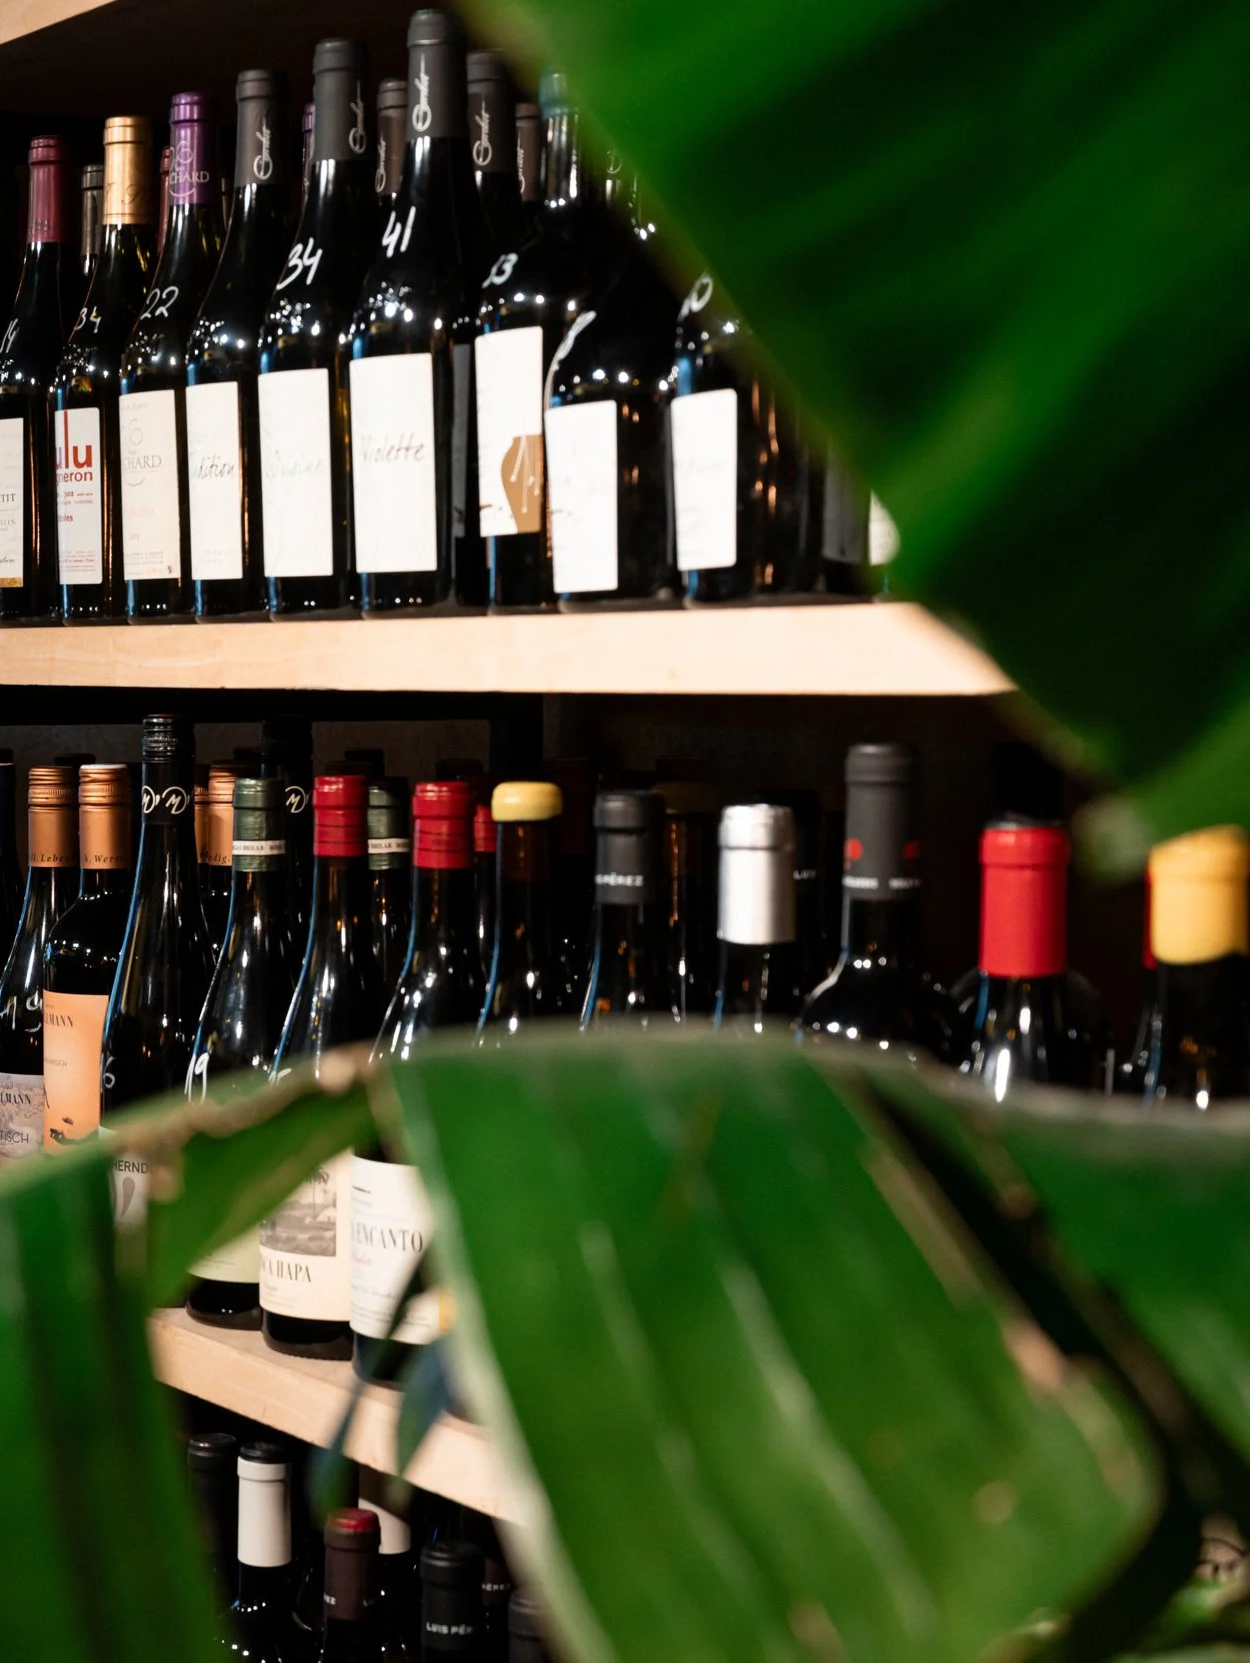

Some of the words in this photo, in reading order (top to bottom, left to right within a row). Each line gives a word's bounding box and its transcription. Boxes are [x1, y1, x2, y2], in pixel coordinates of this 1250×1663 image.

[382, 206, 416, 259] 41
[276, 237, 323, 291] 34
[140, 286, 179, 320] 22
[426, 1622, 448, 1635] LUIS
